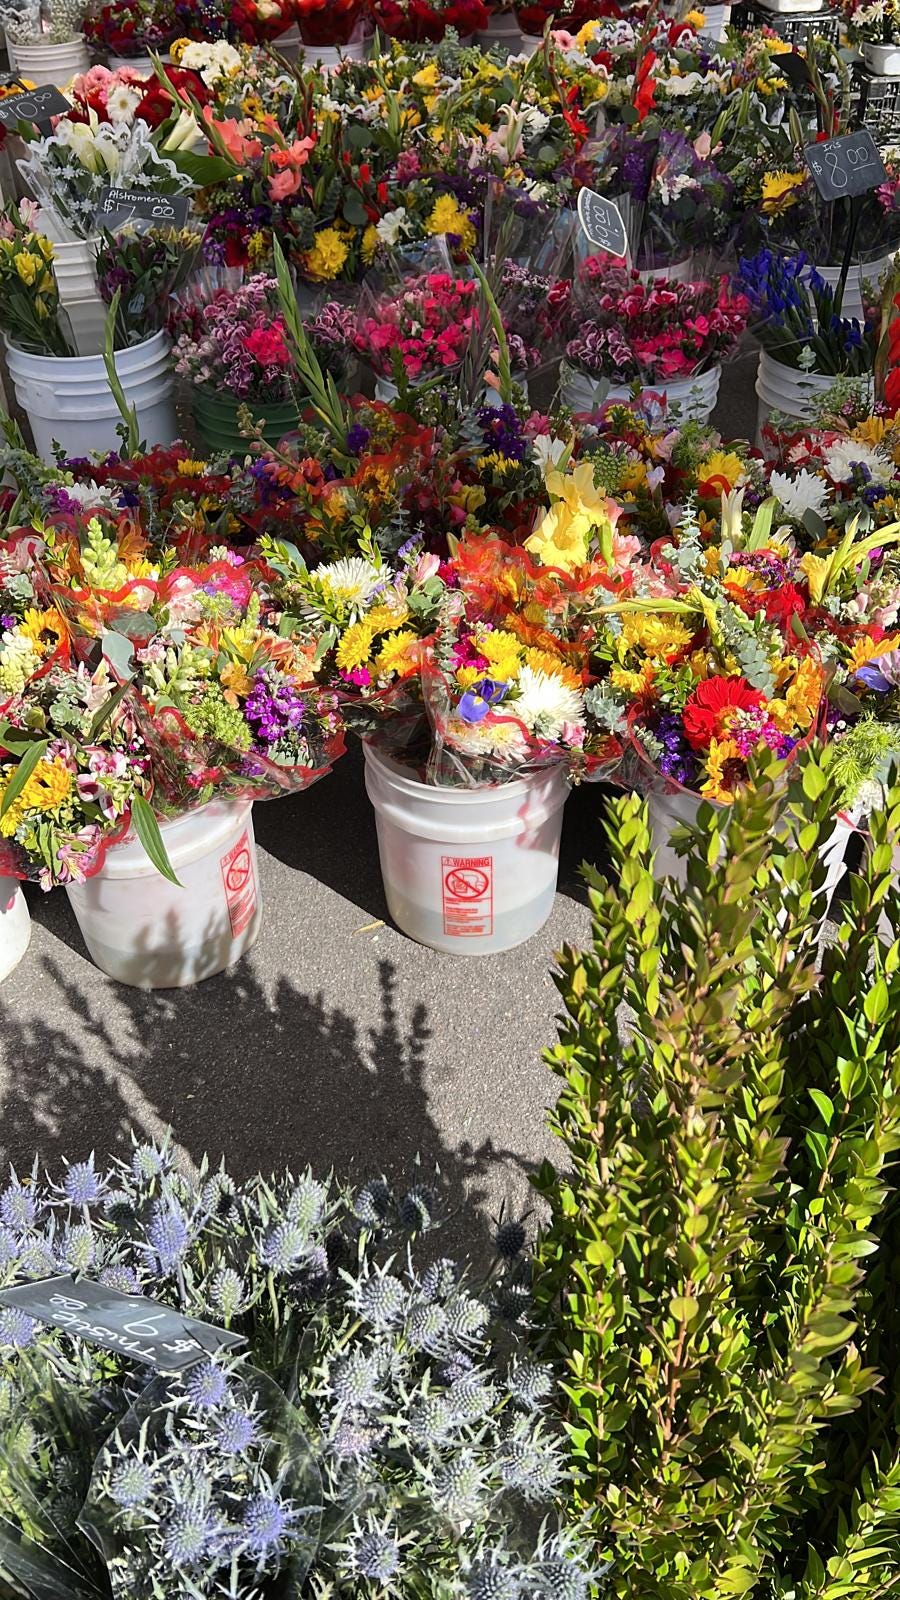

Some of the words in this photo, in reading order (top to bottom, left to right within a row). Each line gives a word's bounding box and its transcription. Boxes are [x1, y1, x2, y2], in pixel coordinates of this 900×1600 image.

[822, 141, 842, 152] Iris
[108, 190, 170, 205] Alstromeria
[453, 858, 490, 867] WARNING
[52, 1311, 157, 1361] Thistle
